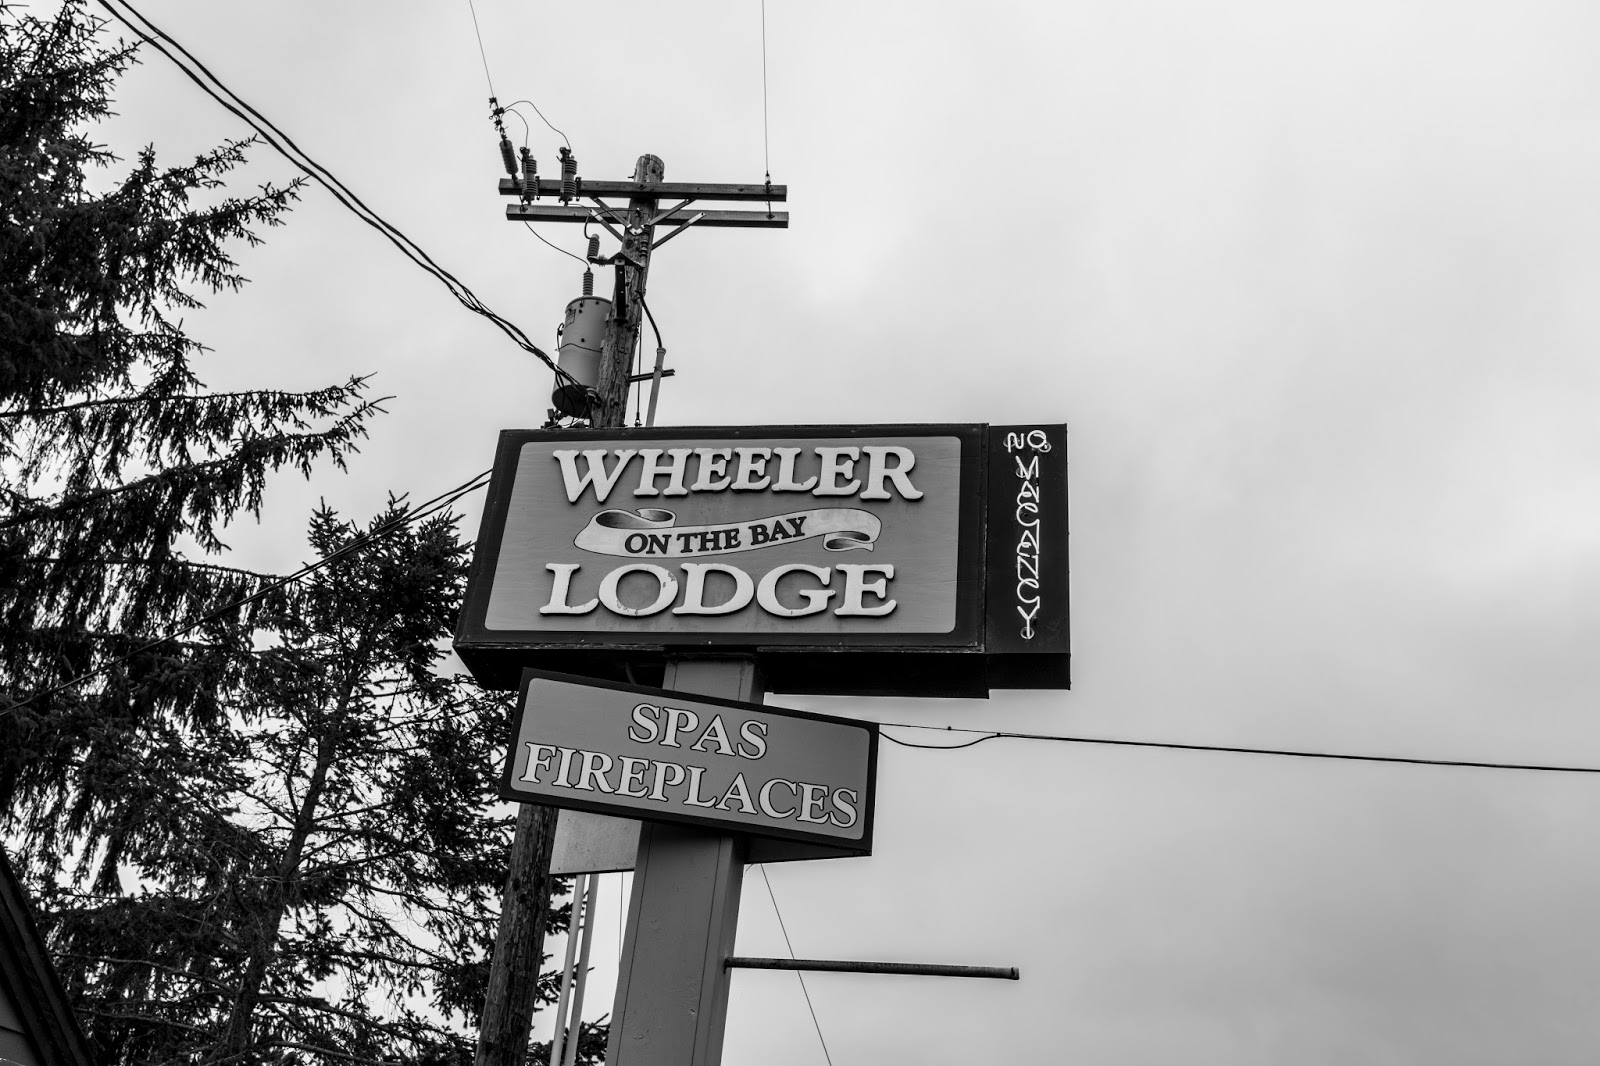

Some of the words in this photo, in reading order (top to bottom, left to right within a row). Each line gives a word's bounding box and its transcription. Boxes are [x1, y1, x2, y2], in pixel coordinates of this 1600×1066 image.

[1005, 430, 1048, 453] NO
[552, 446, 924, 503] WHEELER
[624, 533, 671, 554] ON
[677, 527, 742, 552] THE
[749, 516, 808, 543] BAY
[1016, 455, 1040, 639] VACANCY
[539, 562, 898, 617] LODGE
[628, 702, 769, 760] SPAS
[519, 742, 859, 829] FIREPLACES
